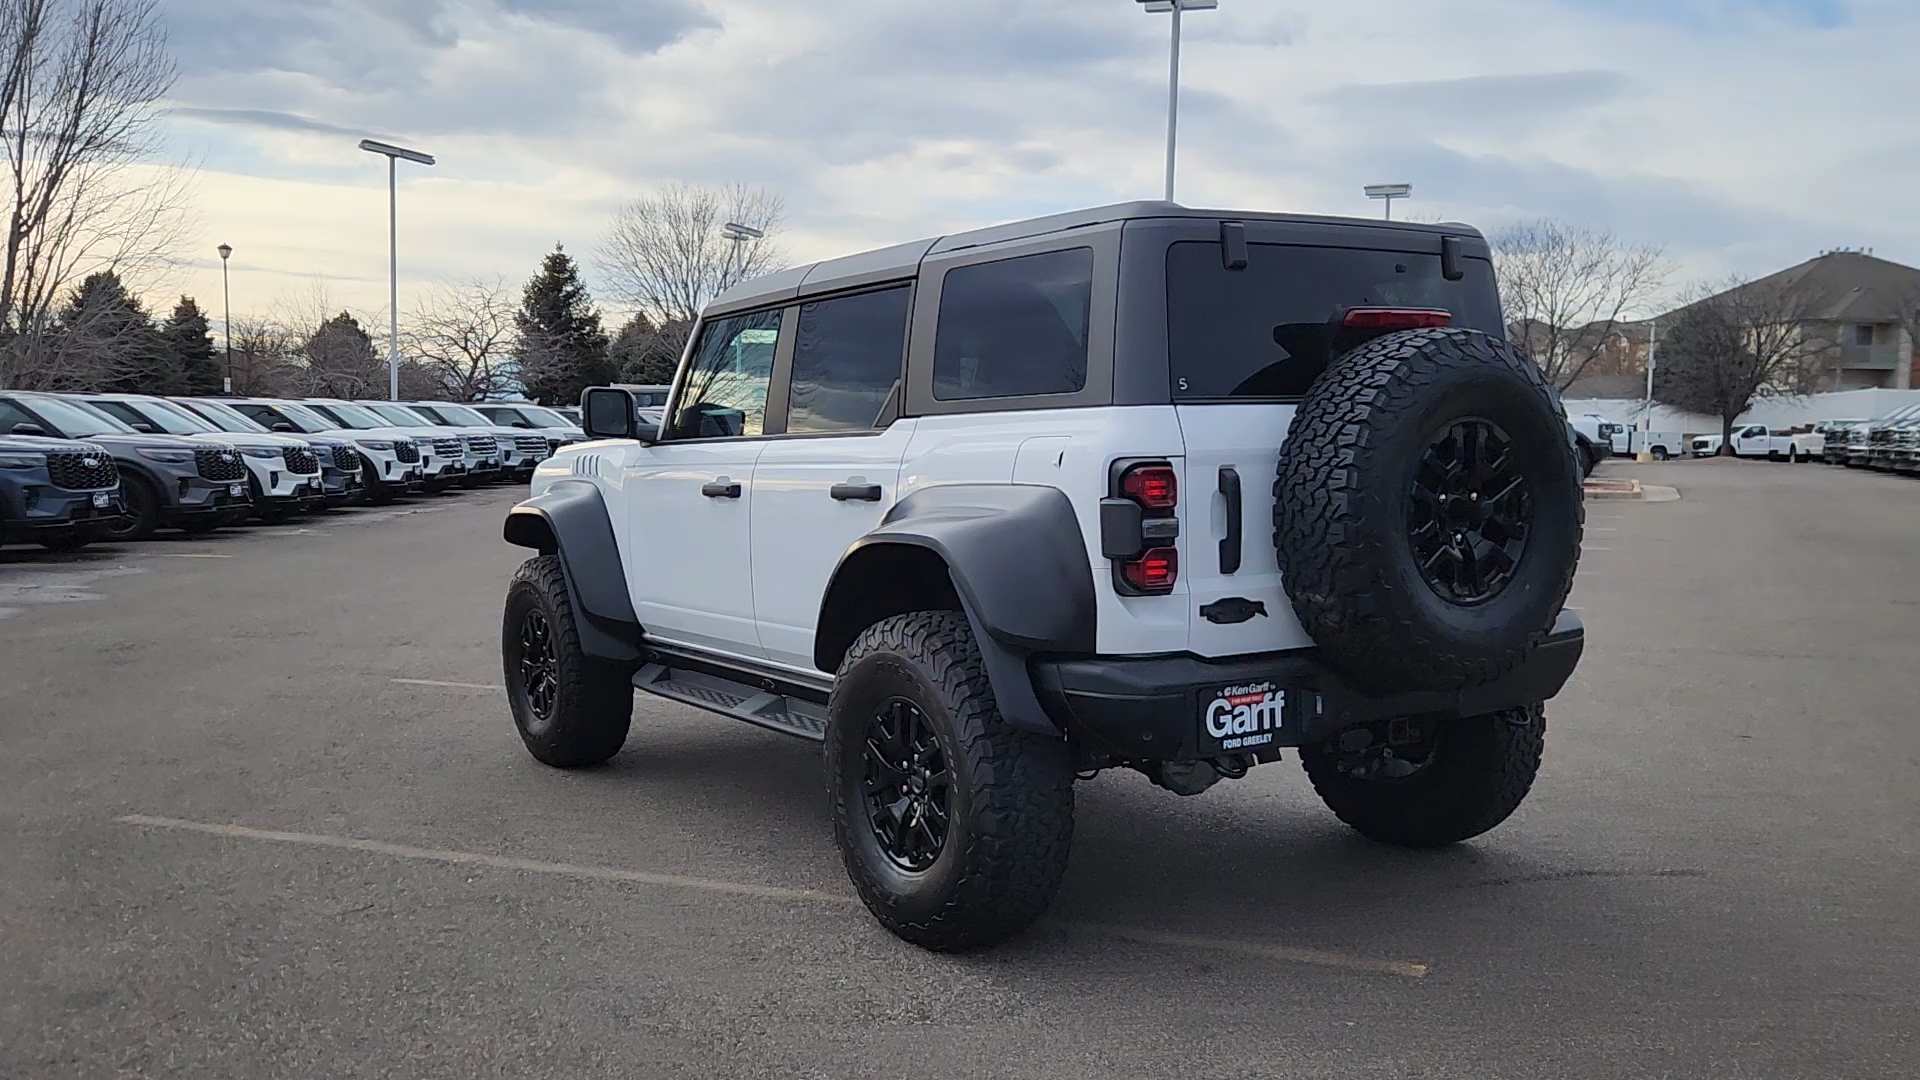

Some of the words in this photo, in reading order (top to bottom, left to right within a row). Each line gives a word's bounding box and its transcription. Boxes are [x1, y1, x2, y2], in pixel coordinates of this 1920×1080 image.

[1179, 378, 1188, 390] S
[1231, 686, 1249, 695] Ken
[1249, 681, 1270, 693] Garff
[1206, 690, 1285, 738] Garff
[1223, 738, 1241, 750] FORD
[1242, 733, 1273, 746] GREELEY
